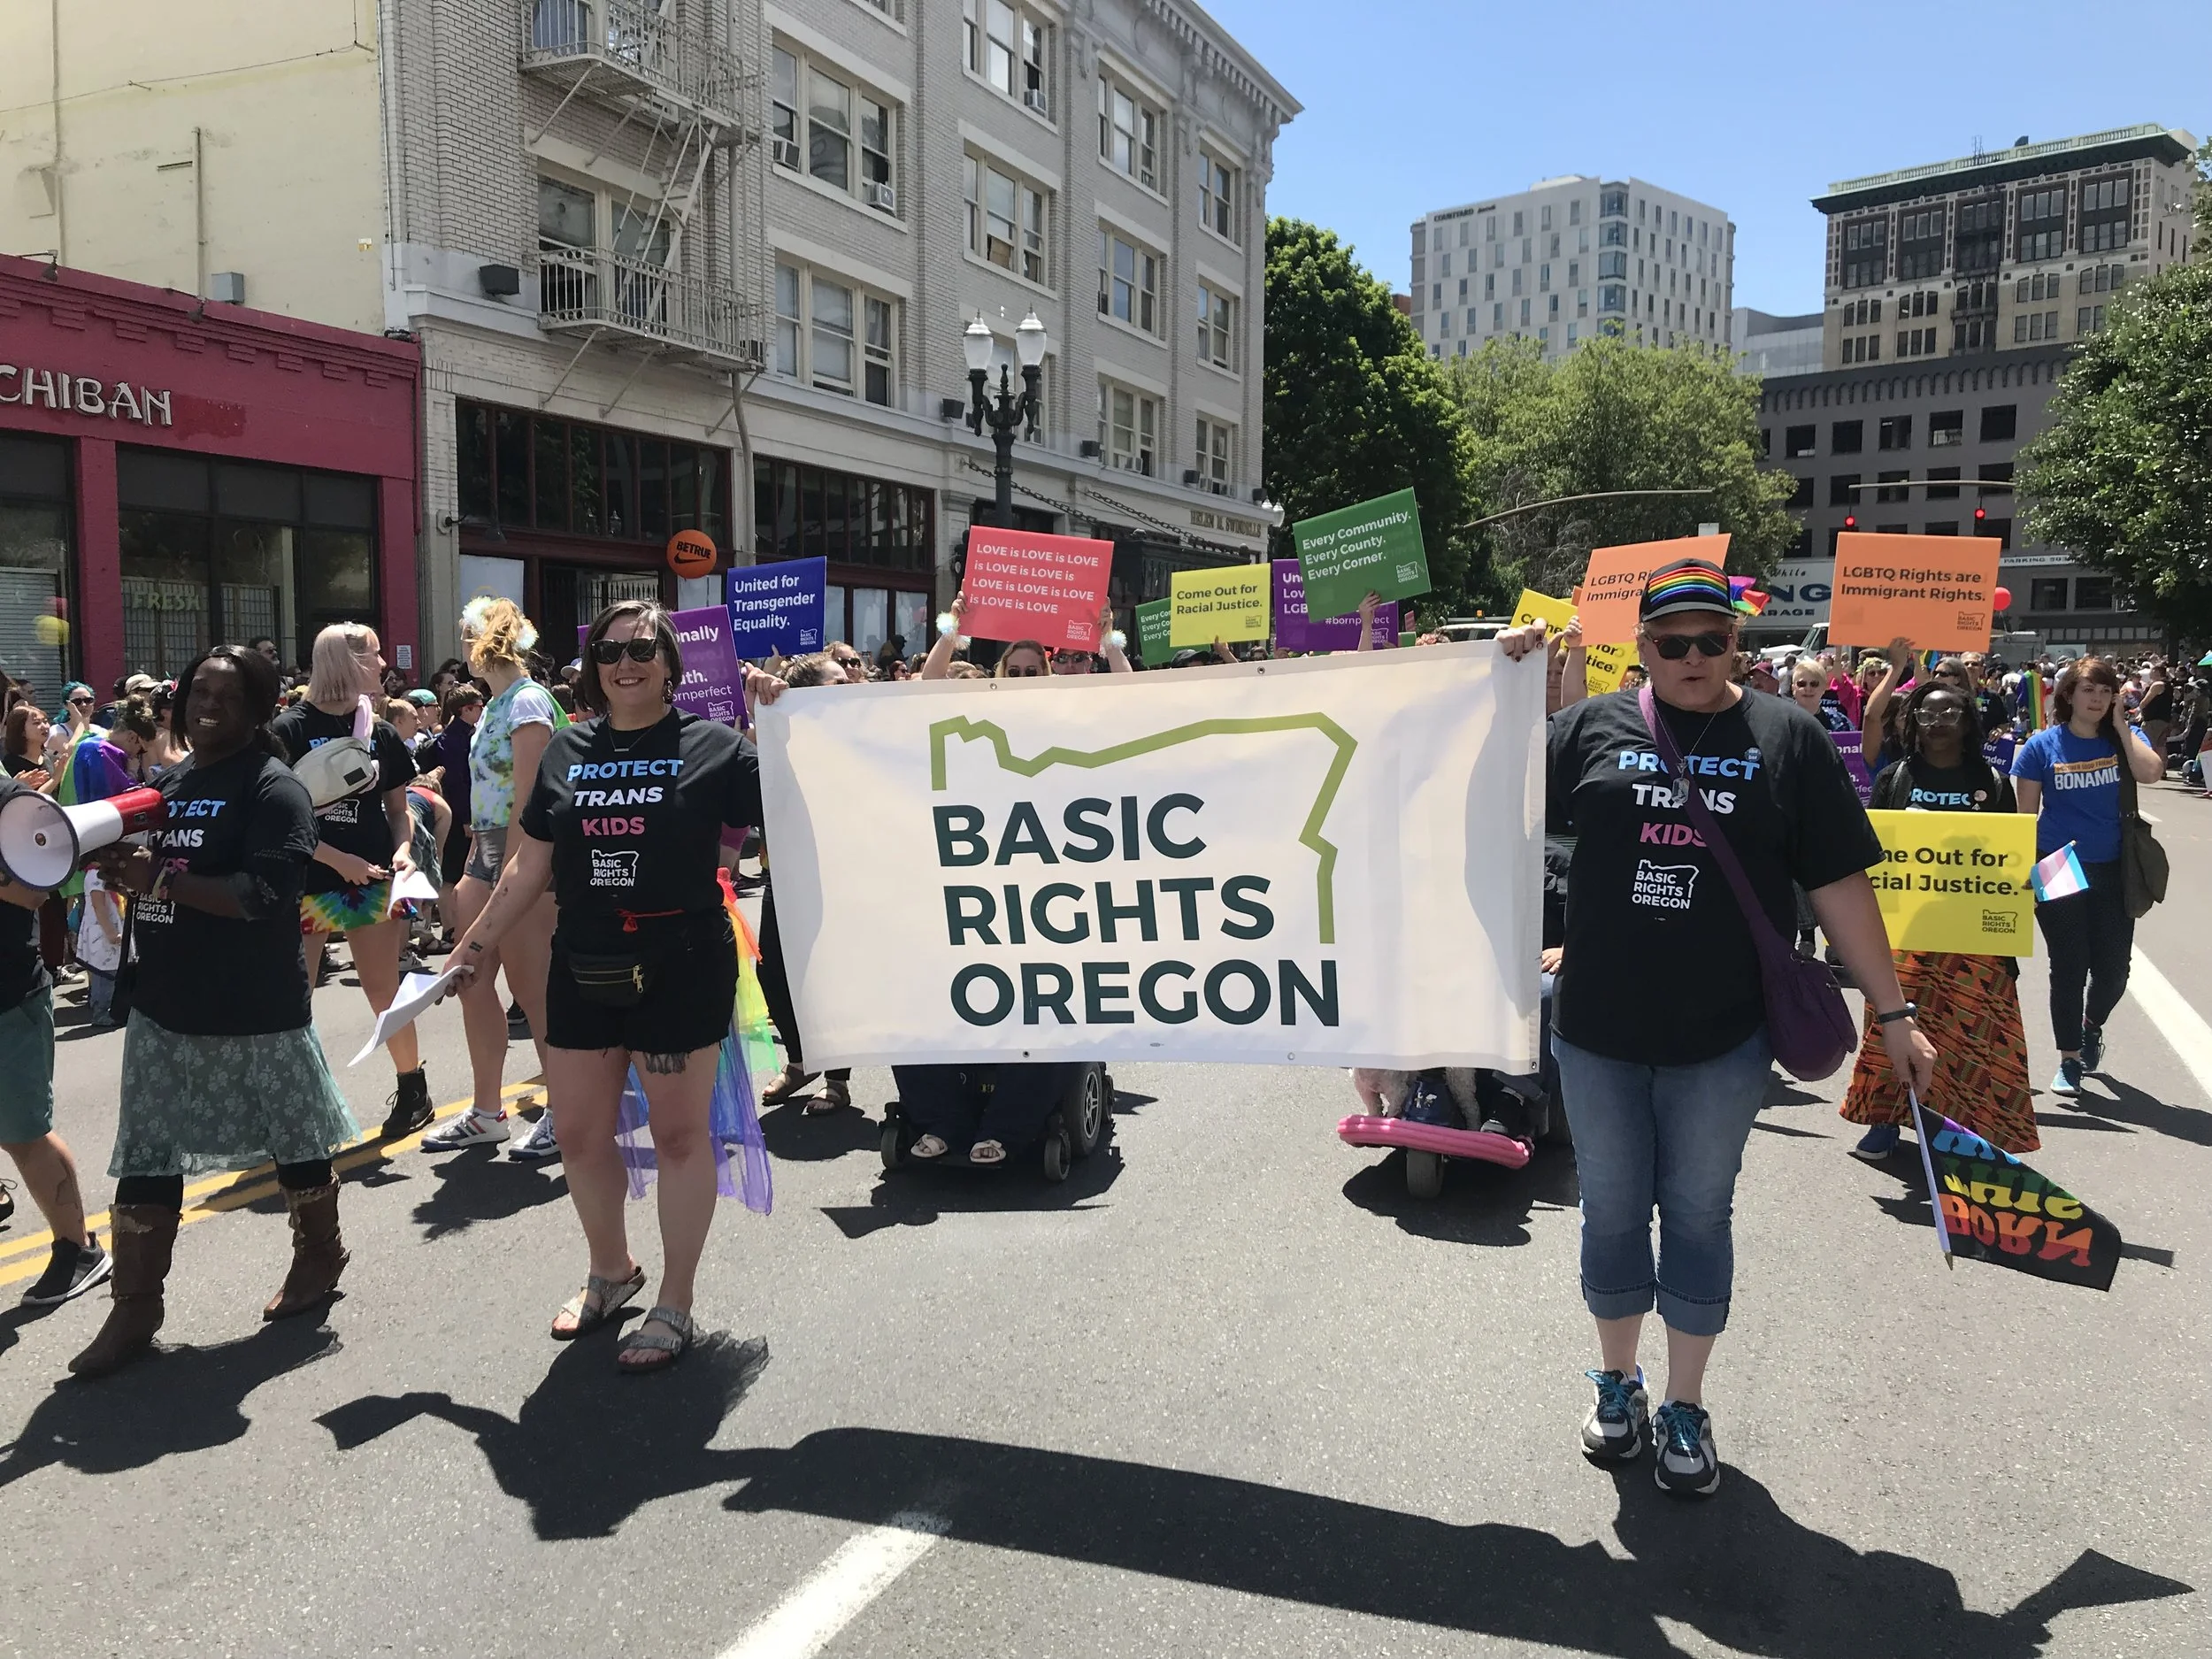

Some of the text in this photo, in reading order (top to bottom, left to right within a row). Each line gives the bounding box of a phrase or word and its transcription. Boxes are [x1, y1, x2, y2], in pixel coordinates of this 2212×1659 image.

[1302, 511, 1412, 549] Every Community.
[977, 544, 1099, 566] LOVE is LOVE is LOVE
[1305, 534, 1386, 565] Every County.
[974, 560, 1074, 581] is LOVE is LOVE is
[1308, 551, 1386, 580] Every Corner.
[1843, 566, 1981, 584] LGBTQ Rights are
[734, 574, 799, 594] United for
[1591, 572, 1634, 587] LGBTQ
[972, 578, 1094, 601] LOVE is LOVE is LOVE
[1177, 584, 1257, 600] Come Out for
[1283, 588, 1305, 599] Lov
[1586, 588, 1642, 603] Immigra
[1770, 583, 1832, 603] NG
[1841, 584, 1986, 603] Immigrant Rights.
[132, 592, 201, 611] FRESH
[733, 592, 816, 612] Transgender
[970, 595, 1058, 614] is LOVE is LOVE
[1177, 598, 1263, 615] Racial Justice.
[1284, 603, 1309, 614] LGB
[1141, 613, 1159, 623] Every
[1760, 608, 1816, 617] RAGE
[733, 614, 790, 634] Equality.
[1141, 622, 1161, 633] Every
[1143, 632, 1162, 641] Every
[1984, 742, 1997, 752] for
[566, 759, 684, 782] PROTECT
[2055, 765, 2120, 790] BONAMIC
[573, 787, 664, 807] TRANS
[1910, 787, 1971, 806] ROTEC
[325, 815, 357, 824] OREGON
[581, 817, 645, 836] KIDS
[933, 793, 1207, 867] BASIC
[592, 859, 621, 868] BASIC
[1915, 847, 1963, 865] Out
[1970, 849, 2008, 867] for
[589, 878, 634, 887] OREGON
[594, 868, 629, 878] RIGHTS
[1635, 871, 1678, 884] BASIC
[1633, 882, 1685, 897] RIGHTS
[1869, 872, 2018, 895] cial Justice.
[138, 902, 167, 913] RIGHTS
[943, 874, 1275, 946] RIGHTS
[1632, 894, 1691, 910] OREGON
[136, 911, 173, 924] OREGON
[950, 958, 1340, 1026] OREGON
